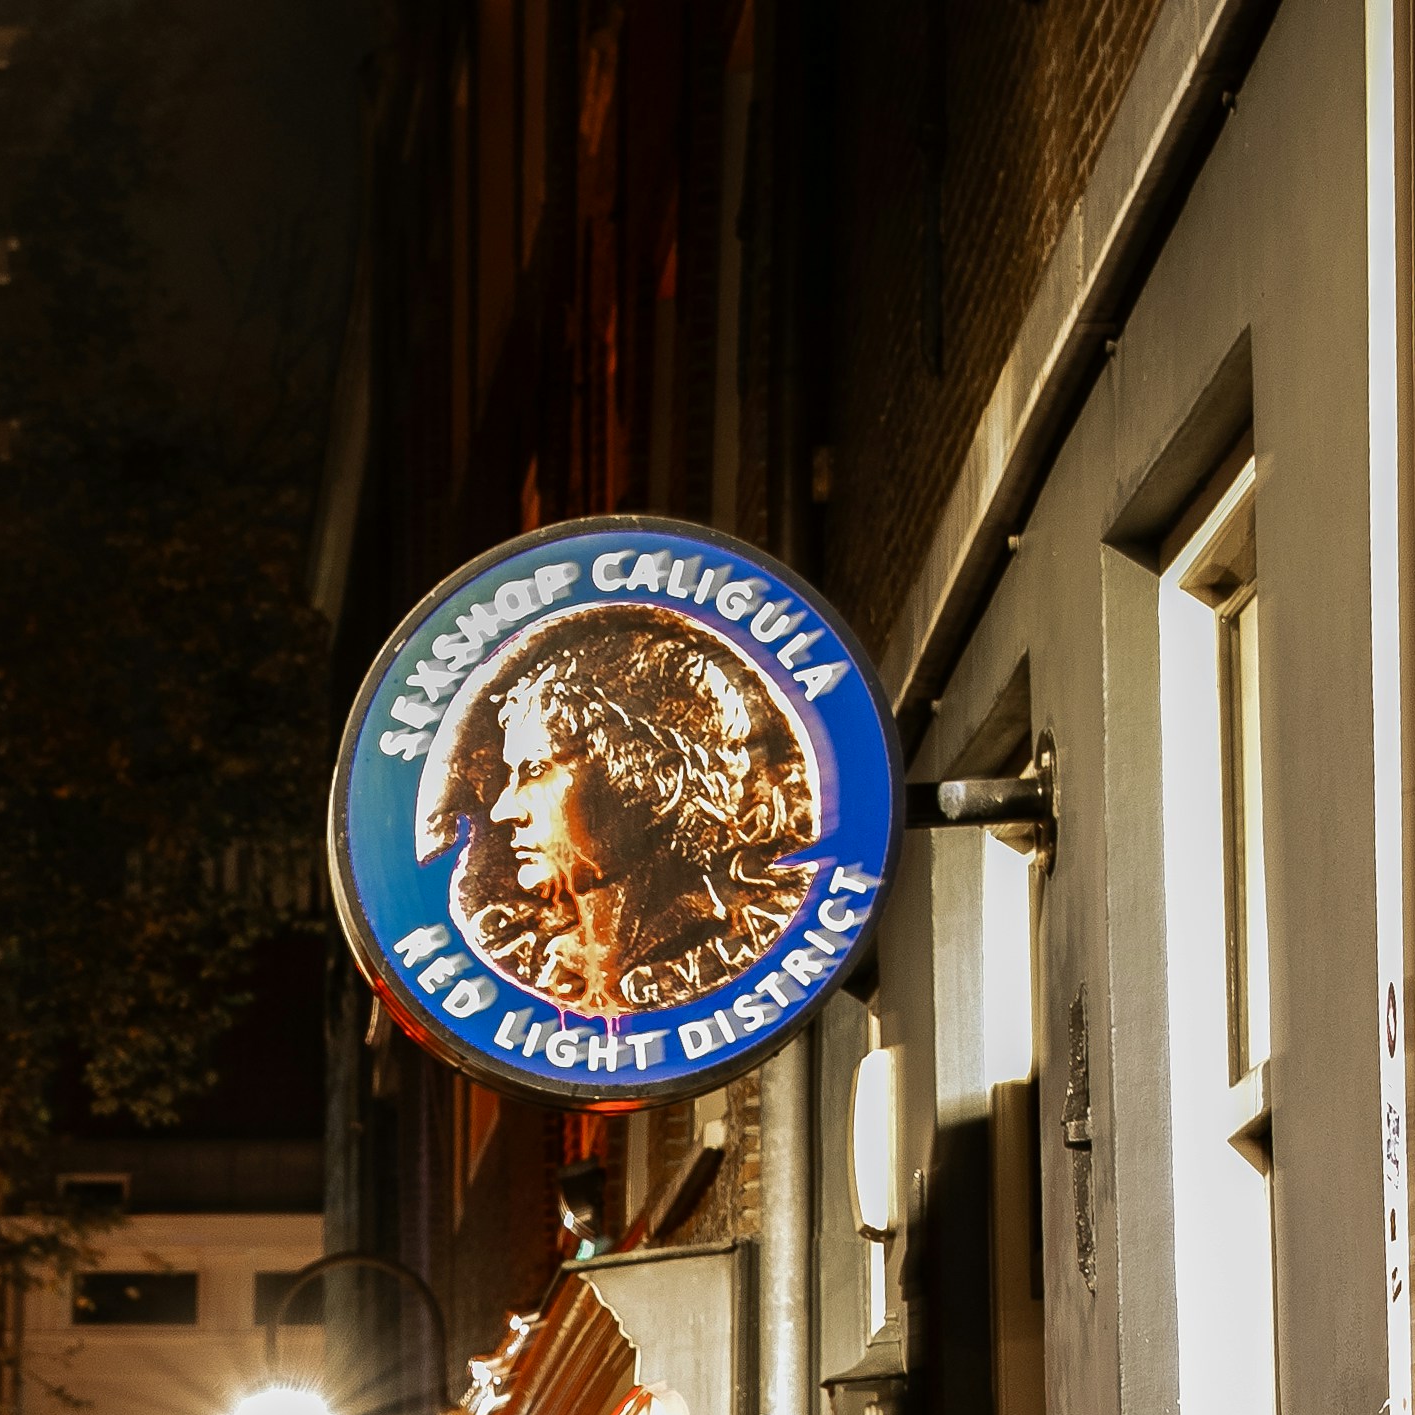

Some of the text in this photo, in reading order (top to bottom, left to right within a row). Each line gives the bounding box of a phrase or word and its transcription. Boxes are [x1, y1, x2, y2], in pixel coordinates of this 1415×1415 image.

[592, 552, 835, 702] CALIGULA
[393, 866, 868, 1073] RED LIGHT DISTRICT
